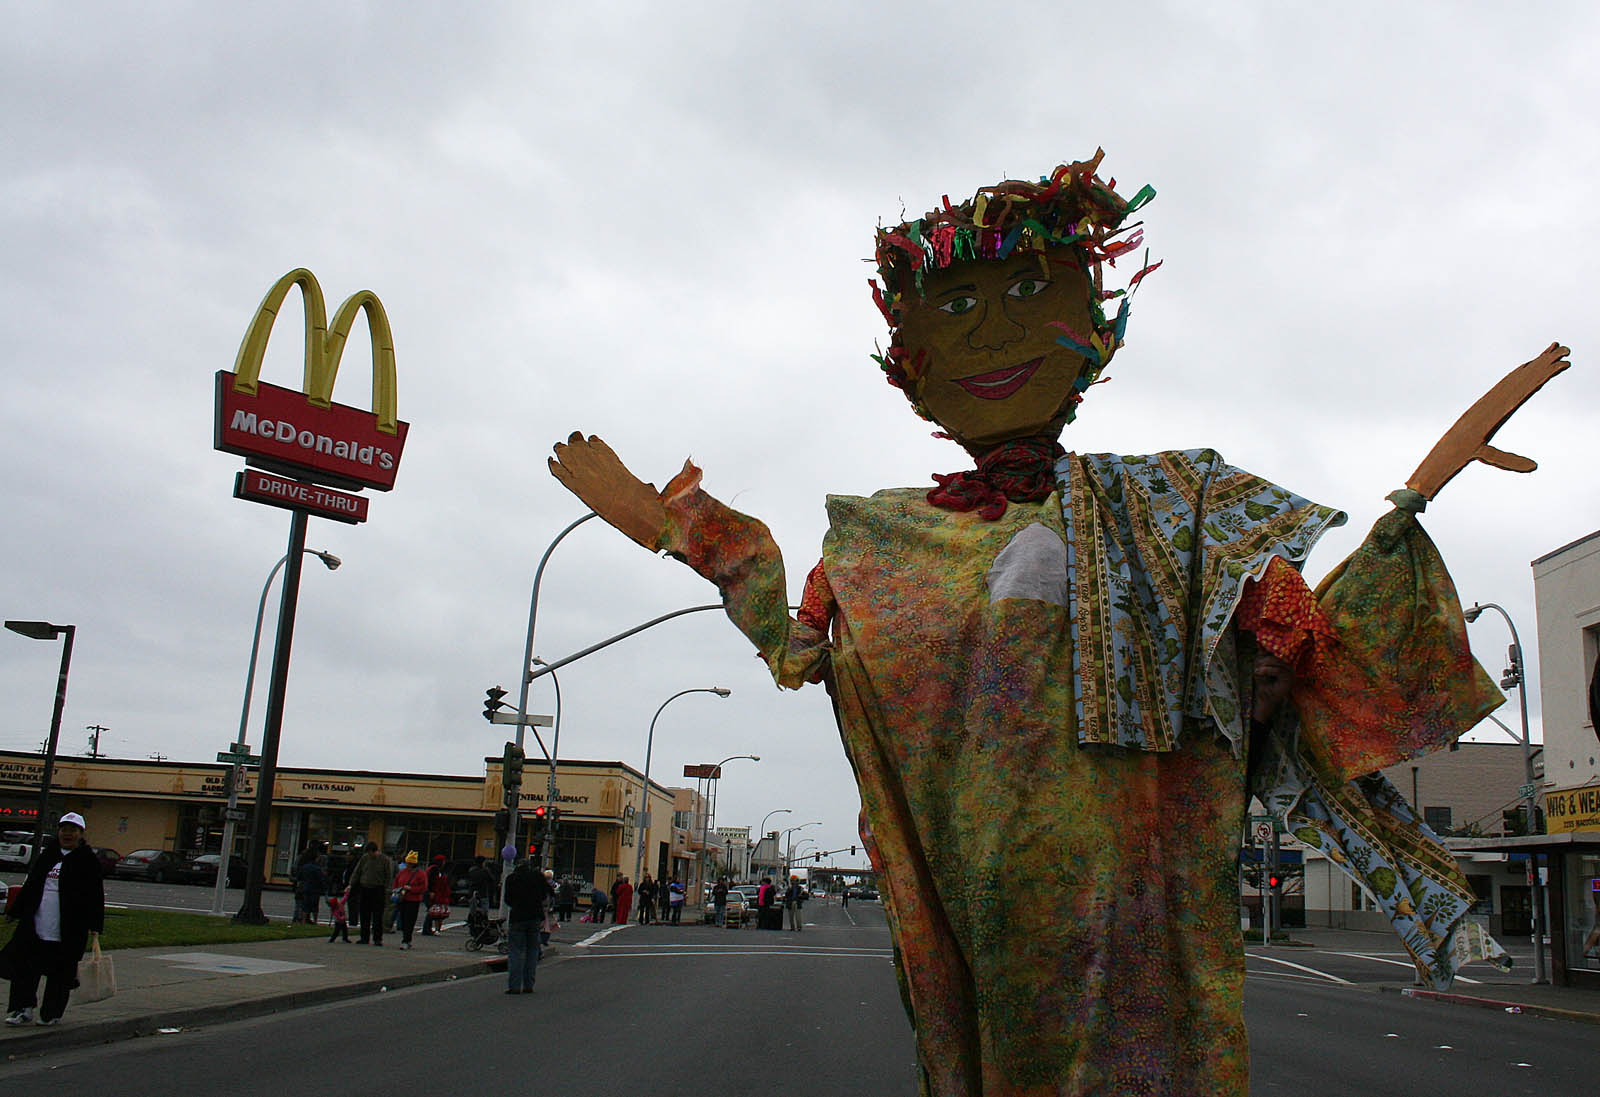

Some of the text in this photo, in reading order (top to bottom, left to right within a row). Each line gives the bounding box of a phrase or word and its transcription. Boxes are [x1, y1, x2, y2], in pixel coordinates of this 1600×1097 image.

[230, 409, 394, 470] McDonald's
[257, 478, 359, 513] DRIVE-THRU
[302, 783, 355, 792] EVITA'S SALON
[546, 794, 589, 804] PARMACY
[1546, 794, 1565, 817] WIG
[1568, 794, 1576, 815] &
